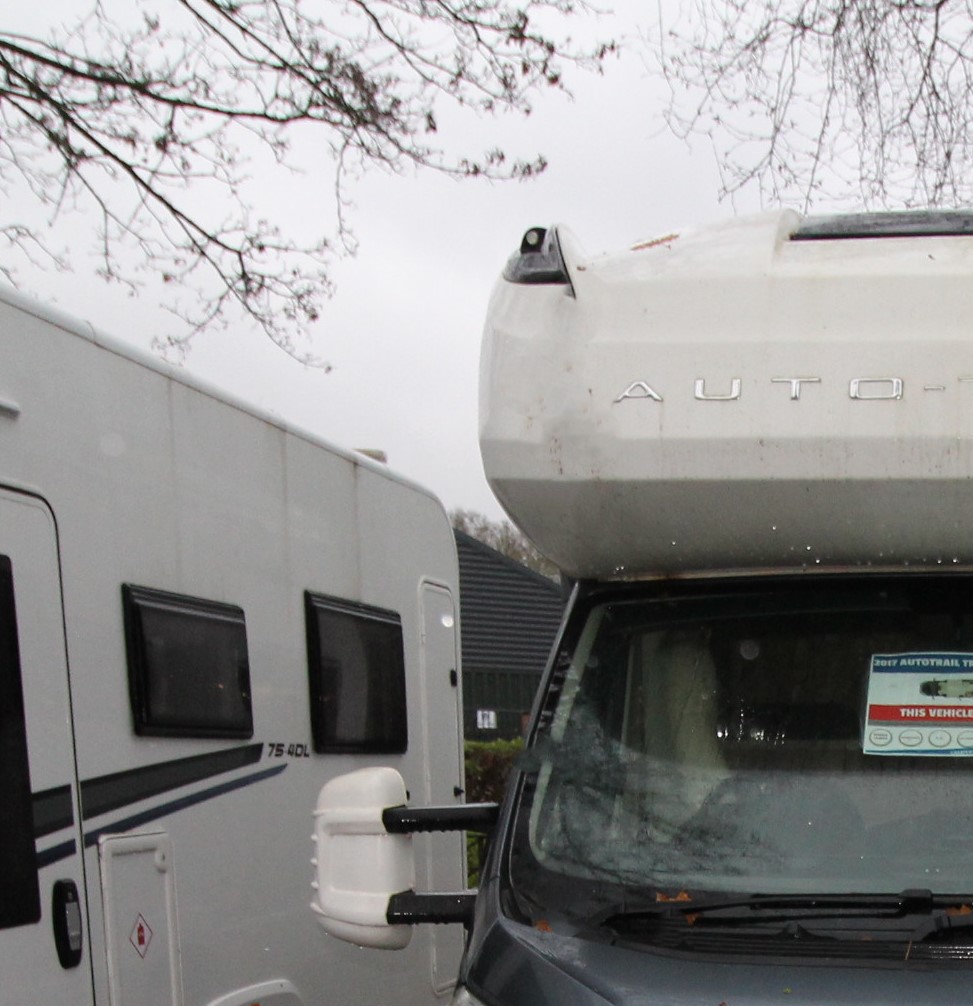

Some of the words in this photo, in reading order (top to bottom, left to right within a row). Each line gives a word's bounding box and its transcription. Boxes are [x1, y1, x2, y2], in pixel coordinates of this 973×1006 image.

[873, 659, 898, 667] 2017
[899, 658, 961, 668] AUTOTRAIL
[900, 708, 927, 718] THIS
